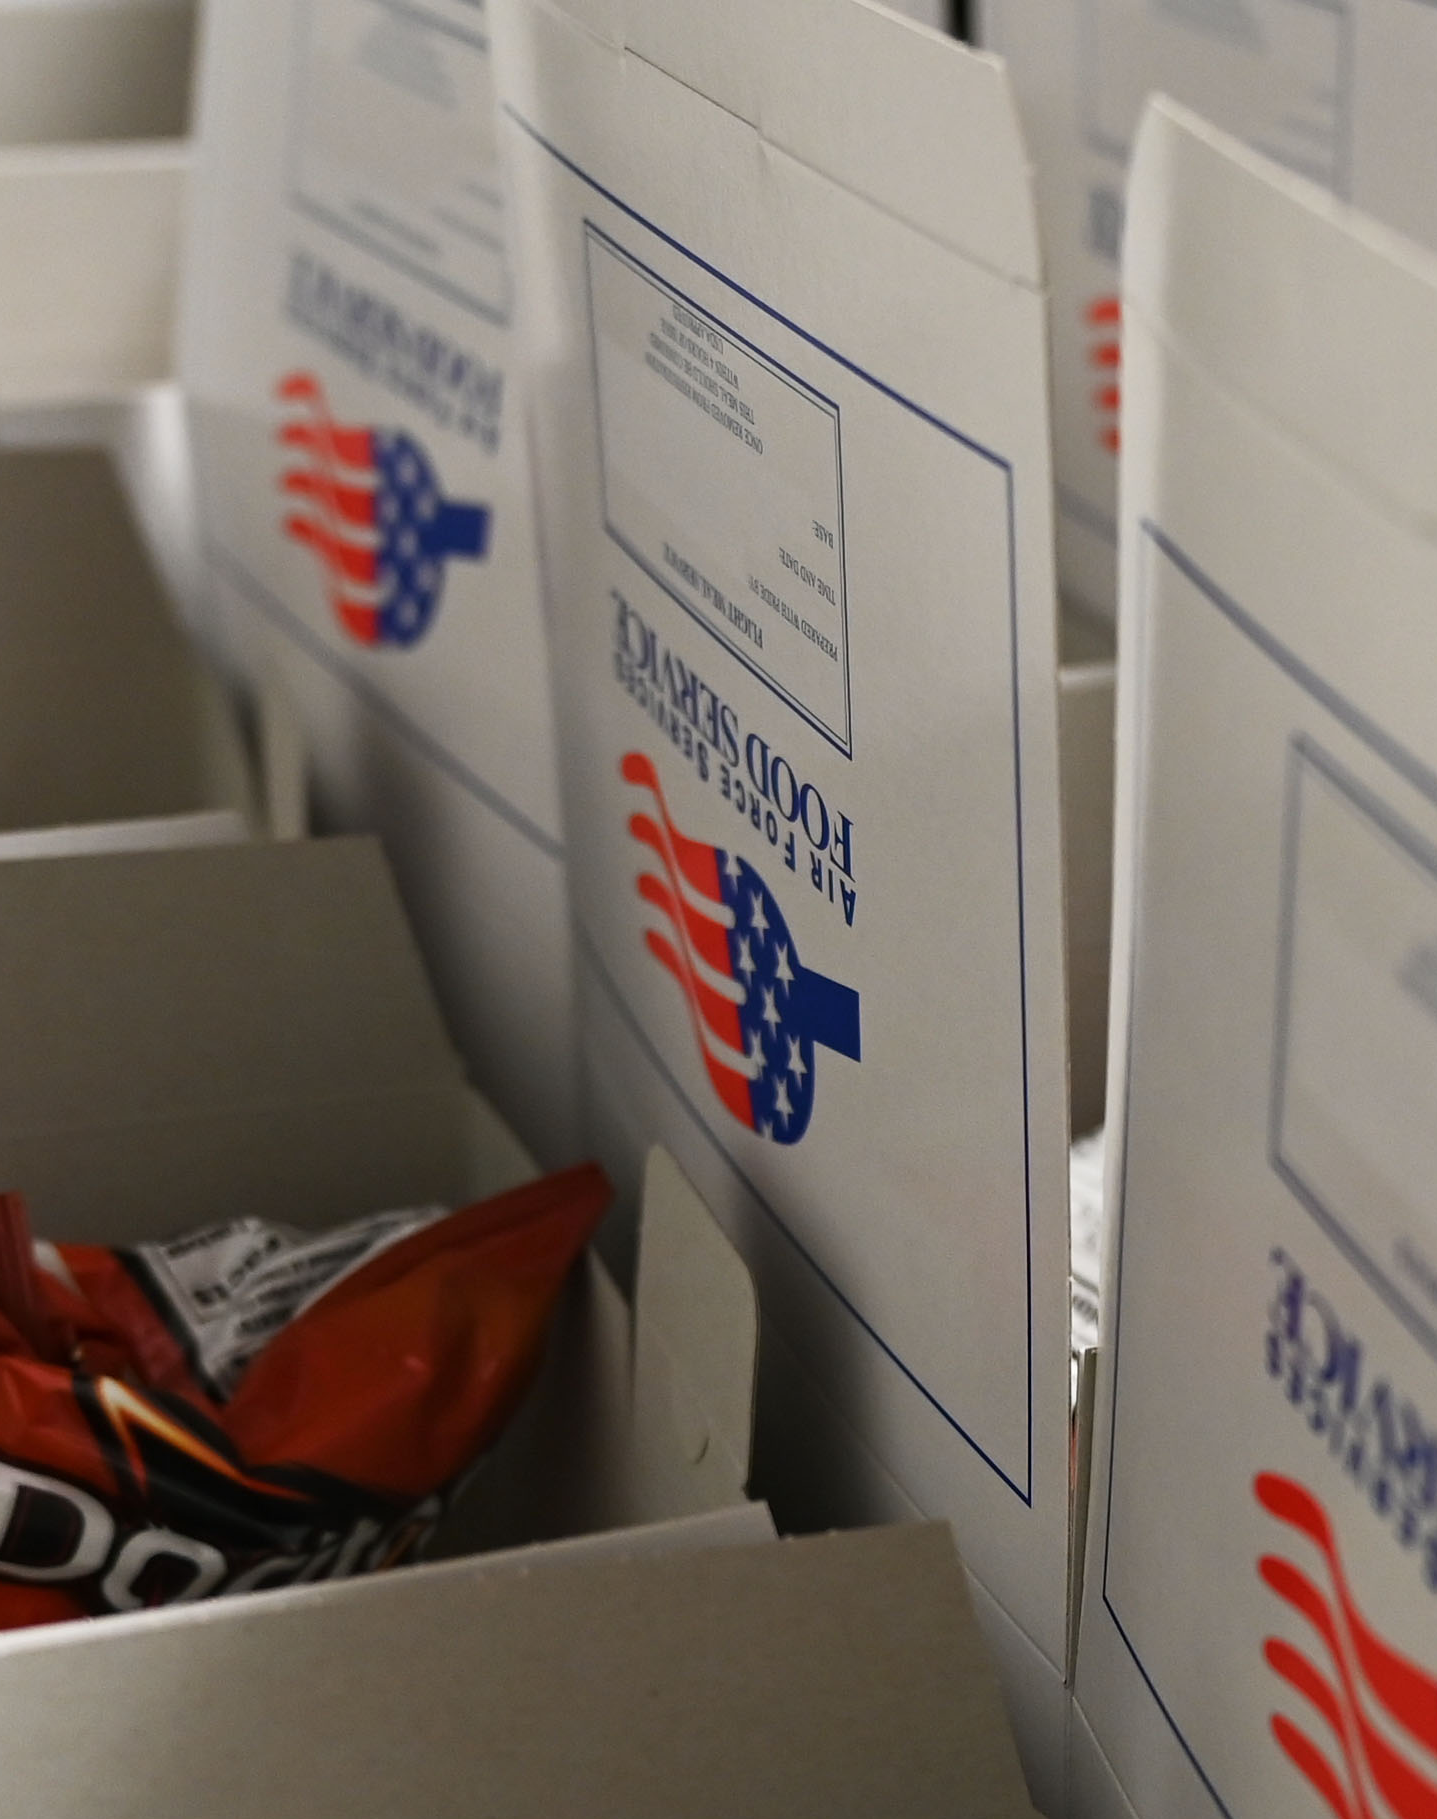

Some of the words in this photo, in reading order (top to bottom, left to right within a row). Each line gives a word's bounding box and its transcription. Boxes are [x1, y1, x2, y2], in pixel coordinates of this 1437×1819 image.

[800, 566, 816, 587] AND
[818, 578, 836, 606] TIME
[728, 602, 763, 649] FLIGHT
[781, 601, 800, 631] WITH
[801, 620, 838, 662] PREPARED
[611, 586, 739, 768] SERVICE
[613, 652, 709, 782] SERVICES
[721, 763, 795, 872] FORCE
[746, 732, 856, 882] FOOD
[811, 851, 856, 927] AIR
